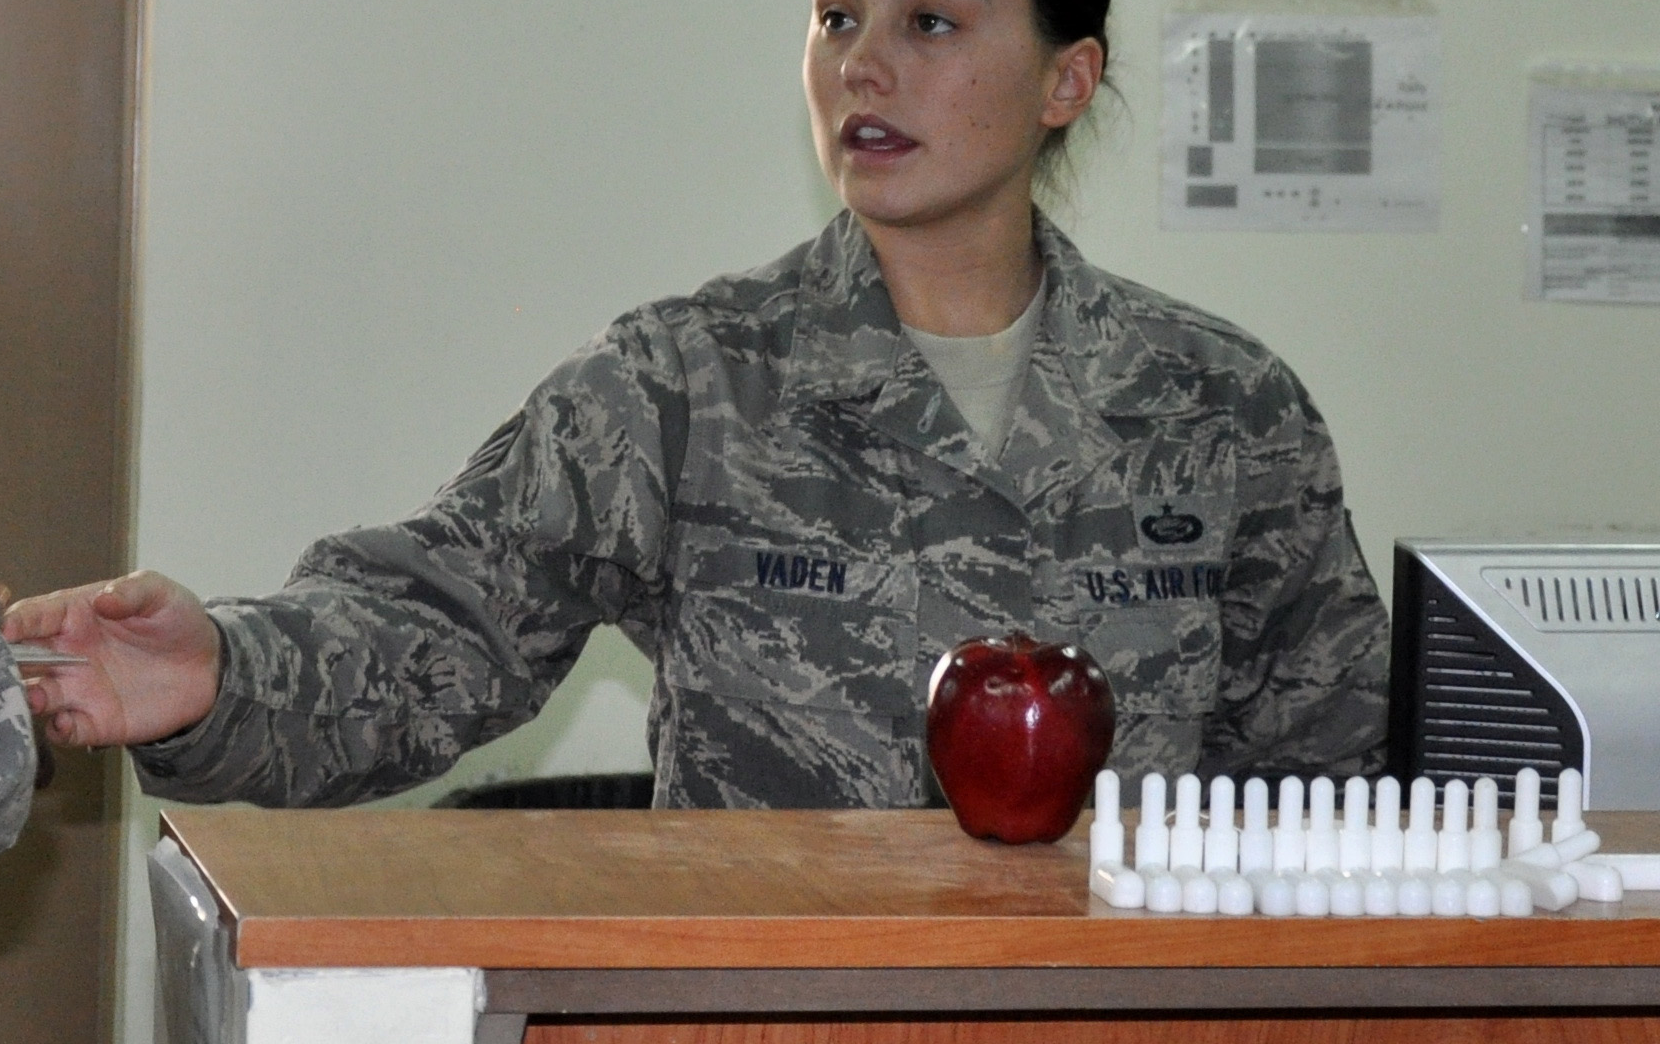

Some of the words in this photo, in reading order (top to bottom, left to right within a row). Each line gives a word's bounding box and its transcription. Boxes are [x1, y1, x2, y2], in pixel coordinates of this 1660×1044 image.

[756, 553, 847, 594] VADEN
[1086, 570, 1139, 604] U.S.
[1145, 566, 1186, 601] AIR
